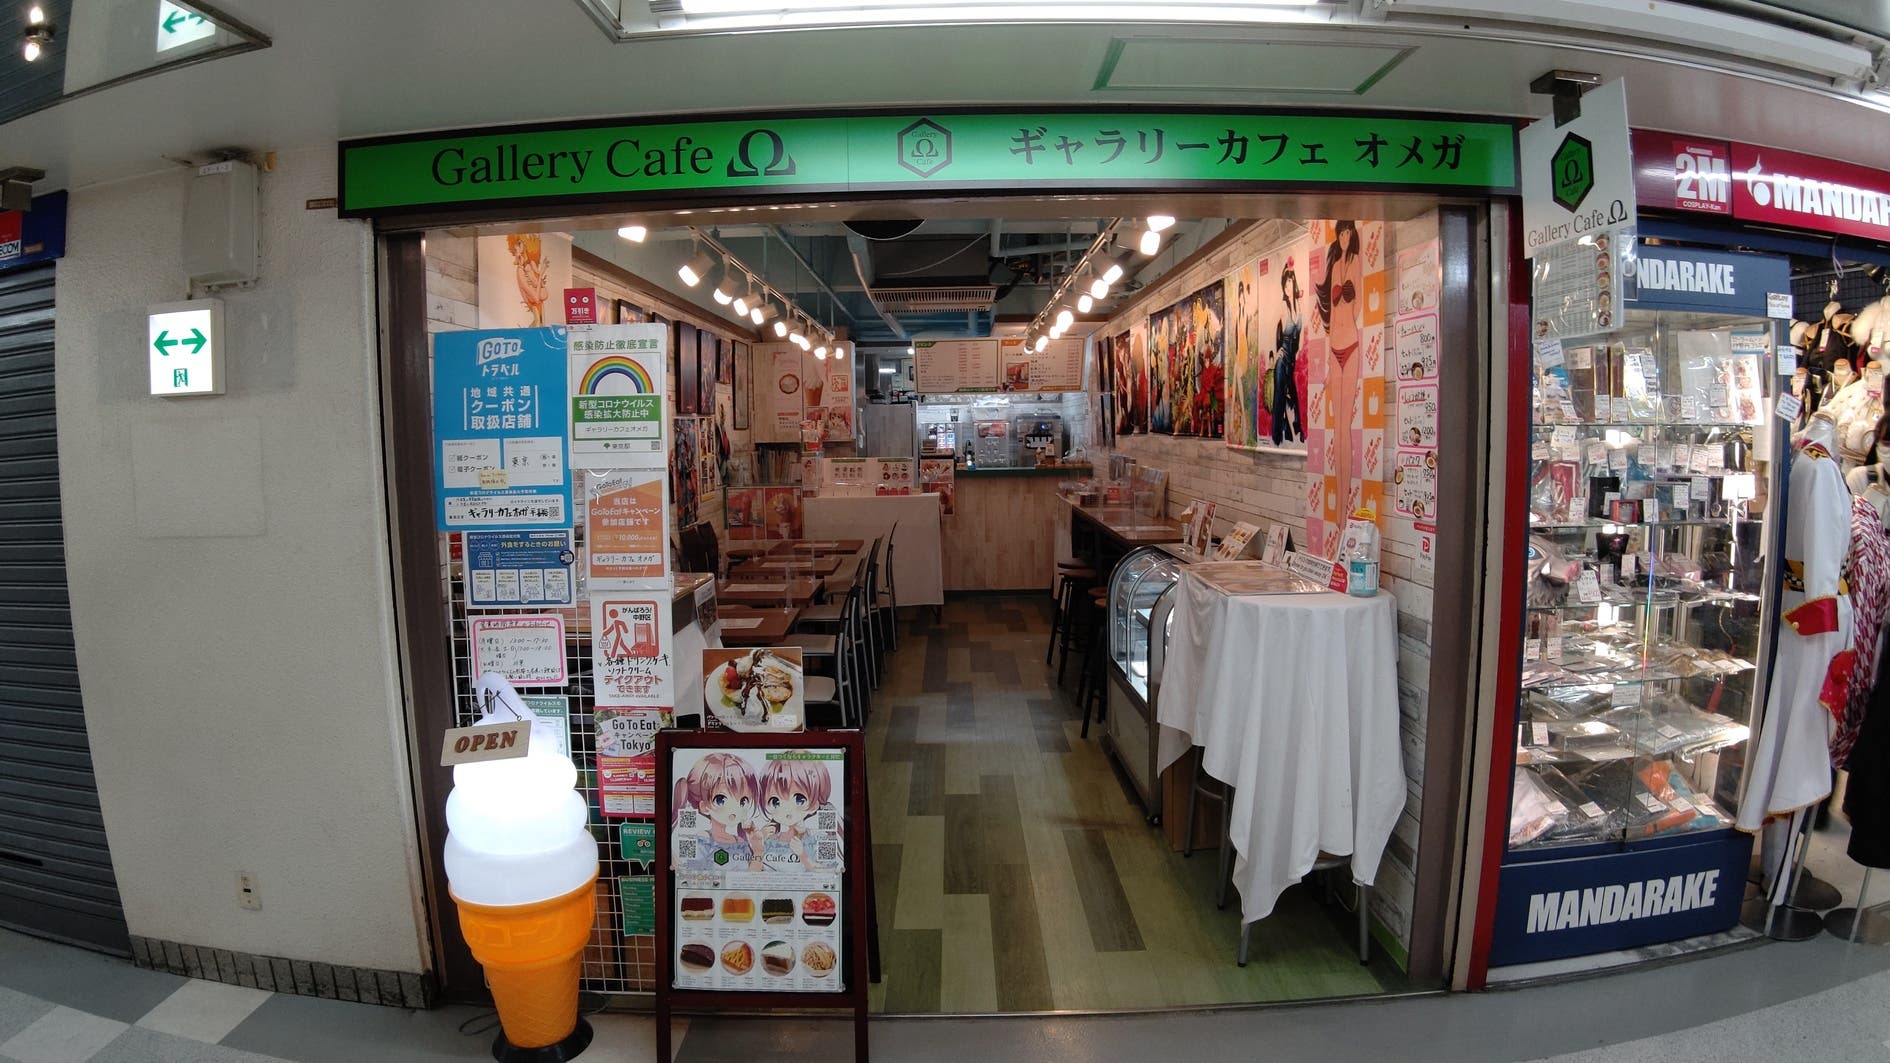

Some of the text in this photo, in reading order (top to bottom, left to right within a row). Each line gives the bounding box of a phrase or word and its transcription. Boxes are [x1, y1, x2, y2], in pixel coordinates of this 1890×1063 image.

[911, 139, 939, 157] Ω
[1009, 127, 1466, 170] ギャラリーカフェ オメガ
[432, 129, 796, 185] Gallery Cafe Ω
[1561, 160, 1583, 188] Ω
[1676, 153, 1727, 203] 2M
[1528, 200, 1628, 248] Gallery Cafe Ω
[573, 339, 659, 351] 感染防止徹底宣言
[482, 364, 520, 377] トラベル
[470, 385, 531, 398] 地域共通
[471, 399, 531, 413] クーポン
[578, 400, 654, 409] 新型コロナウイルス
[584, 410, 649, 419] 感染拡大防止中
[471, 414, 532, 430] 取扱店舗
[604, 675, 663, 685] テイクアウト
[617, 685, 651, 693] できます
[612, 719, 657, 730] Go To Eat
[454, 730, 518, 753] OPEN
[621, 739, 651, 752] Tokyo
[766, 853, 786, 863] Cafe
[788, 853, 800, 863] Ω
[1526, 869, 1720, 934] MANDARAKE
